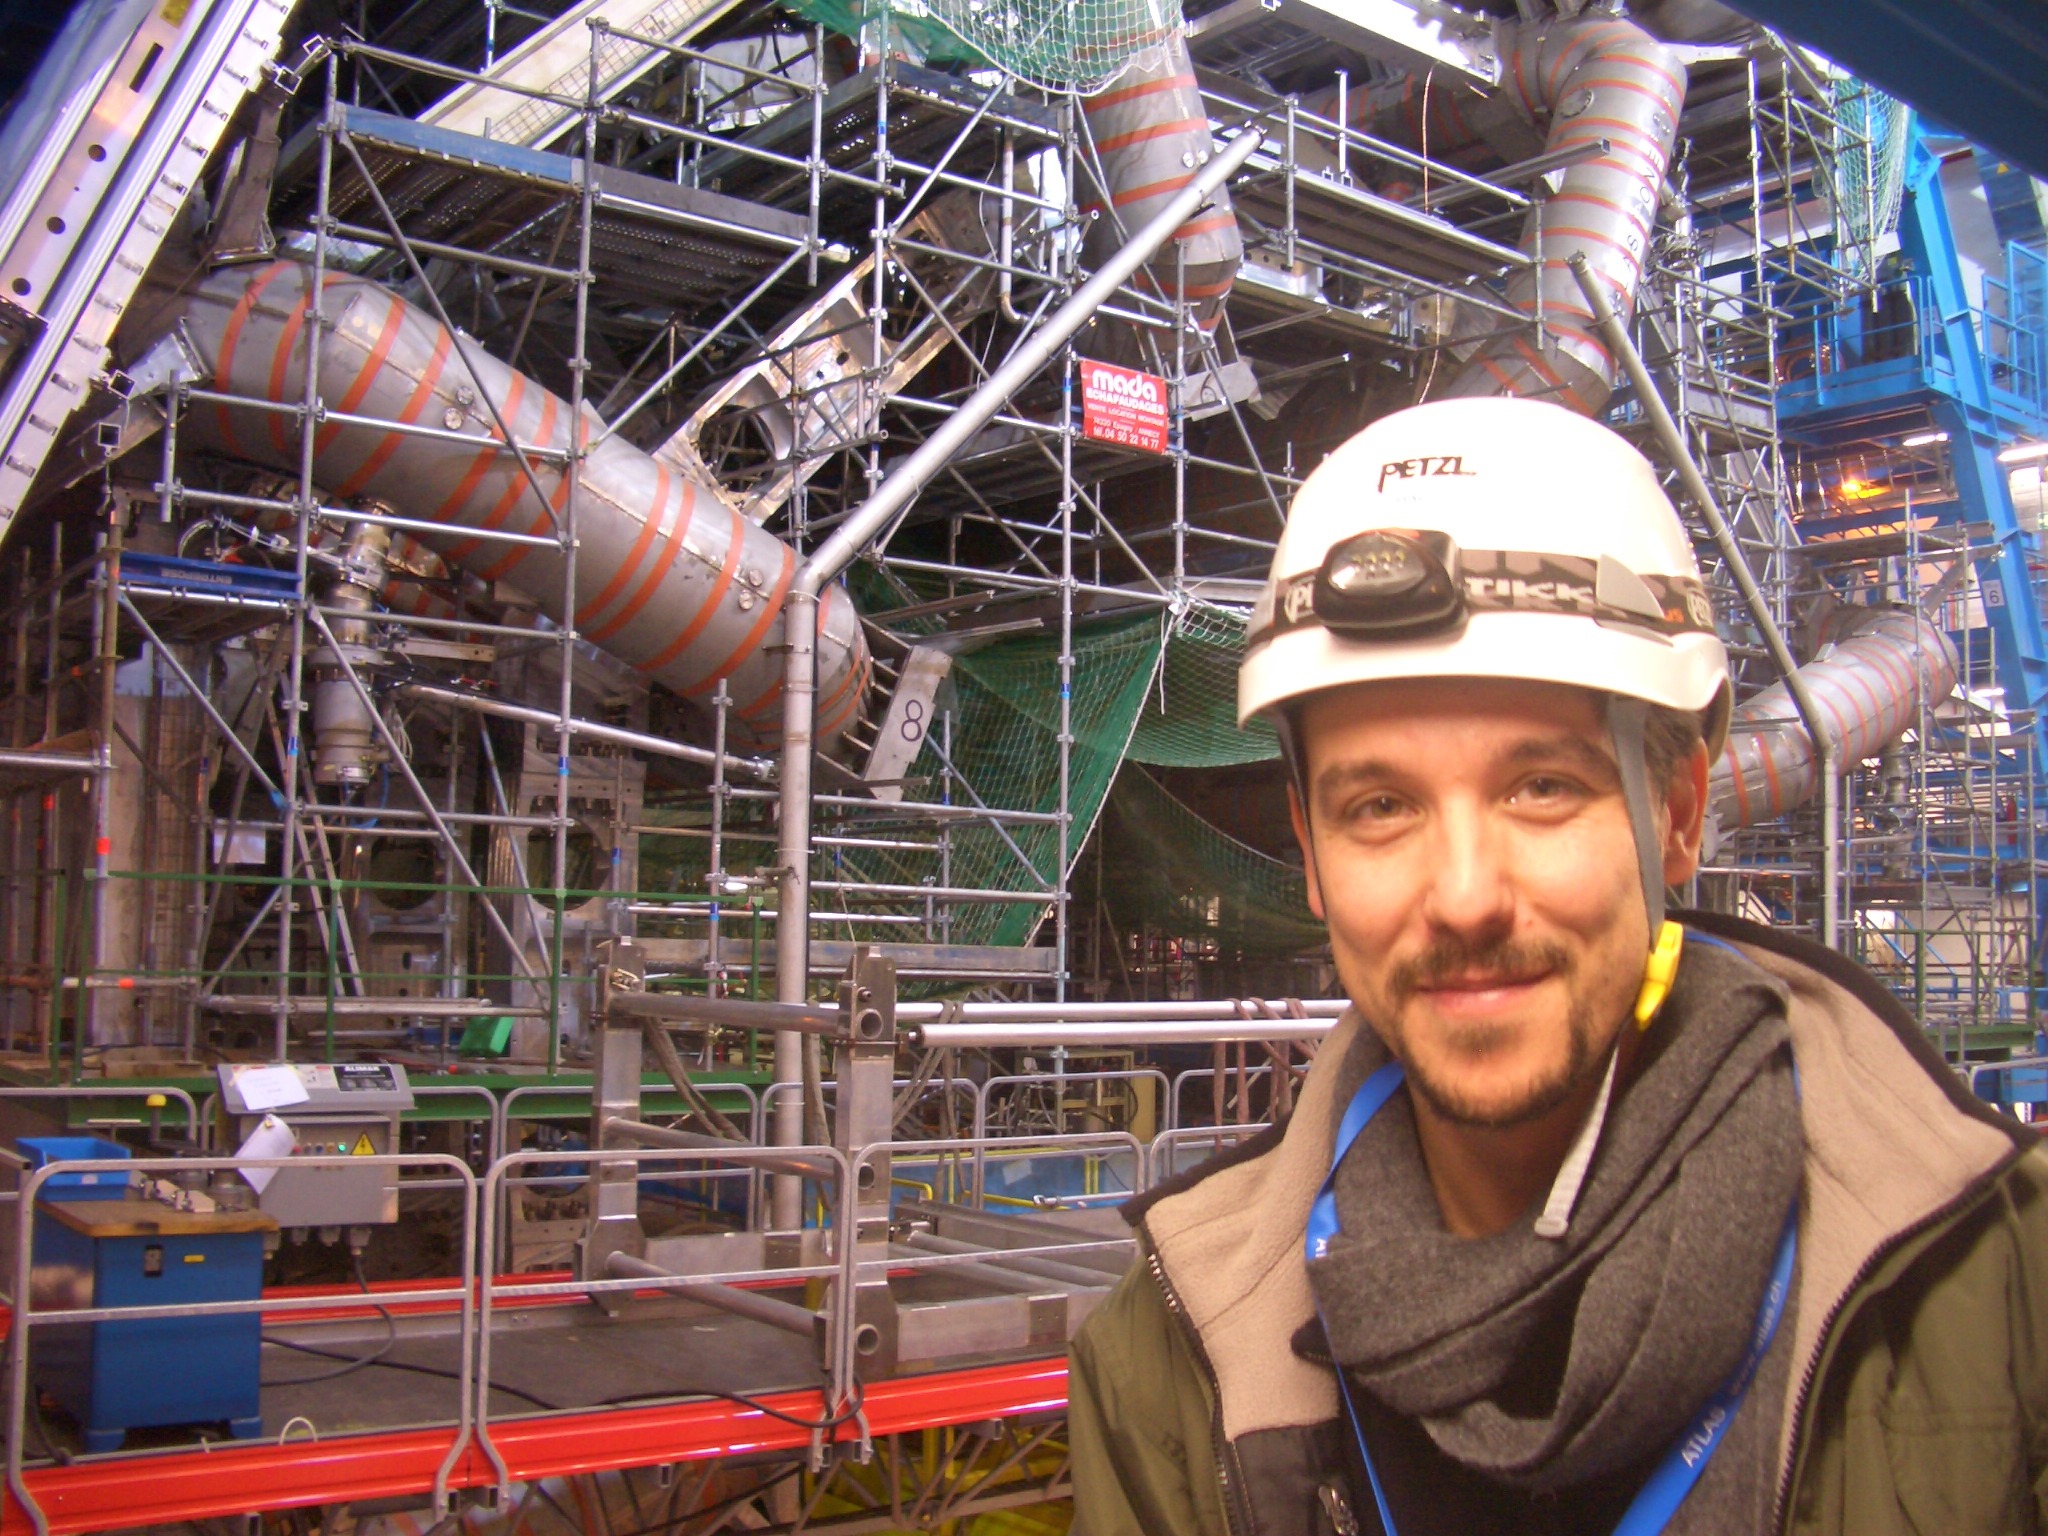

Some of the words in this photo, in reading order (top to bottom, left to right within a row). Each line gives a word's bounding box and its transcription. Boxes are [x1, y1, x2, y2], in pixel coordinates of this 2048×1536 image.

[1092, 370, 1157, 402] mada
[1108, 408, 1136, 420] LOCATION
[1117, 430, 1127, 442] 50
[1129, 433, 1138, 445] 22
[1151, 439, 1159, 449] 77
[1377, 456, 1477, 493] PETZL
[161, 567, 232, 585] ENTREPOSE
[1989, 590, 2000, 604] 6
[901, 699, 923, 742] 8
